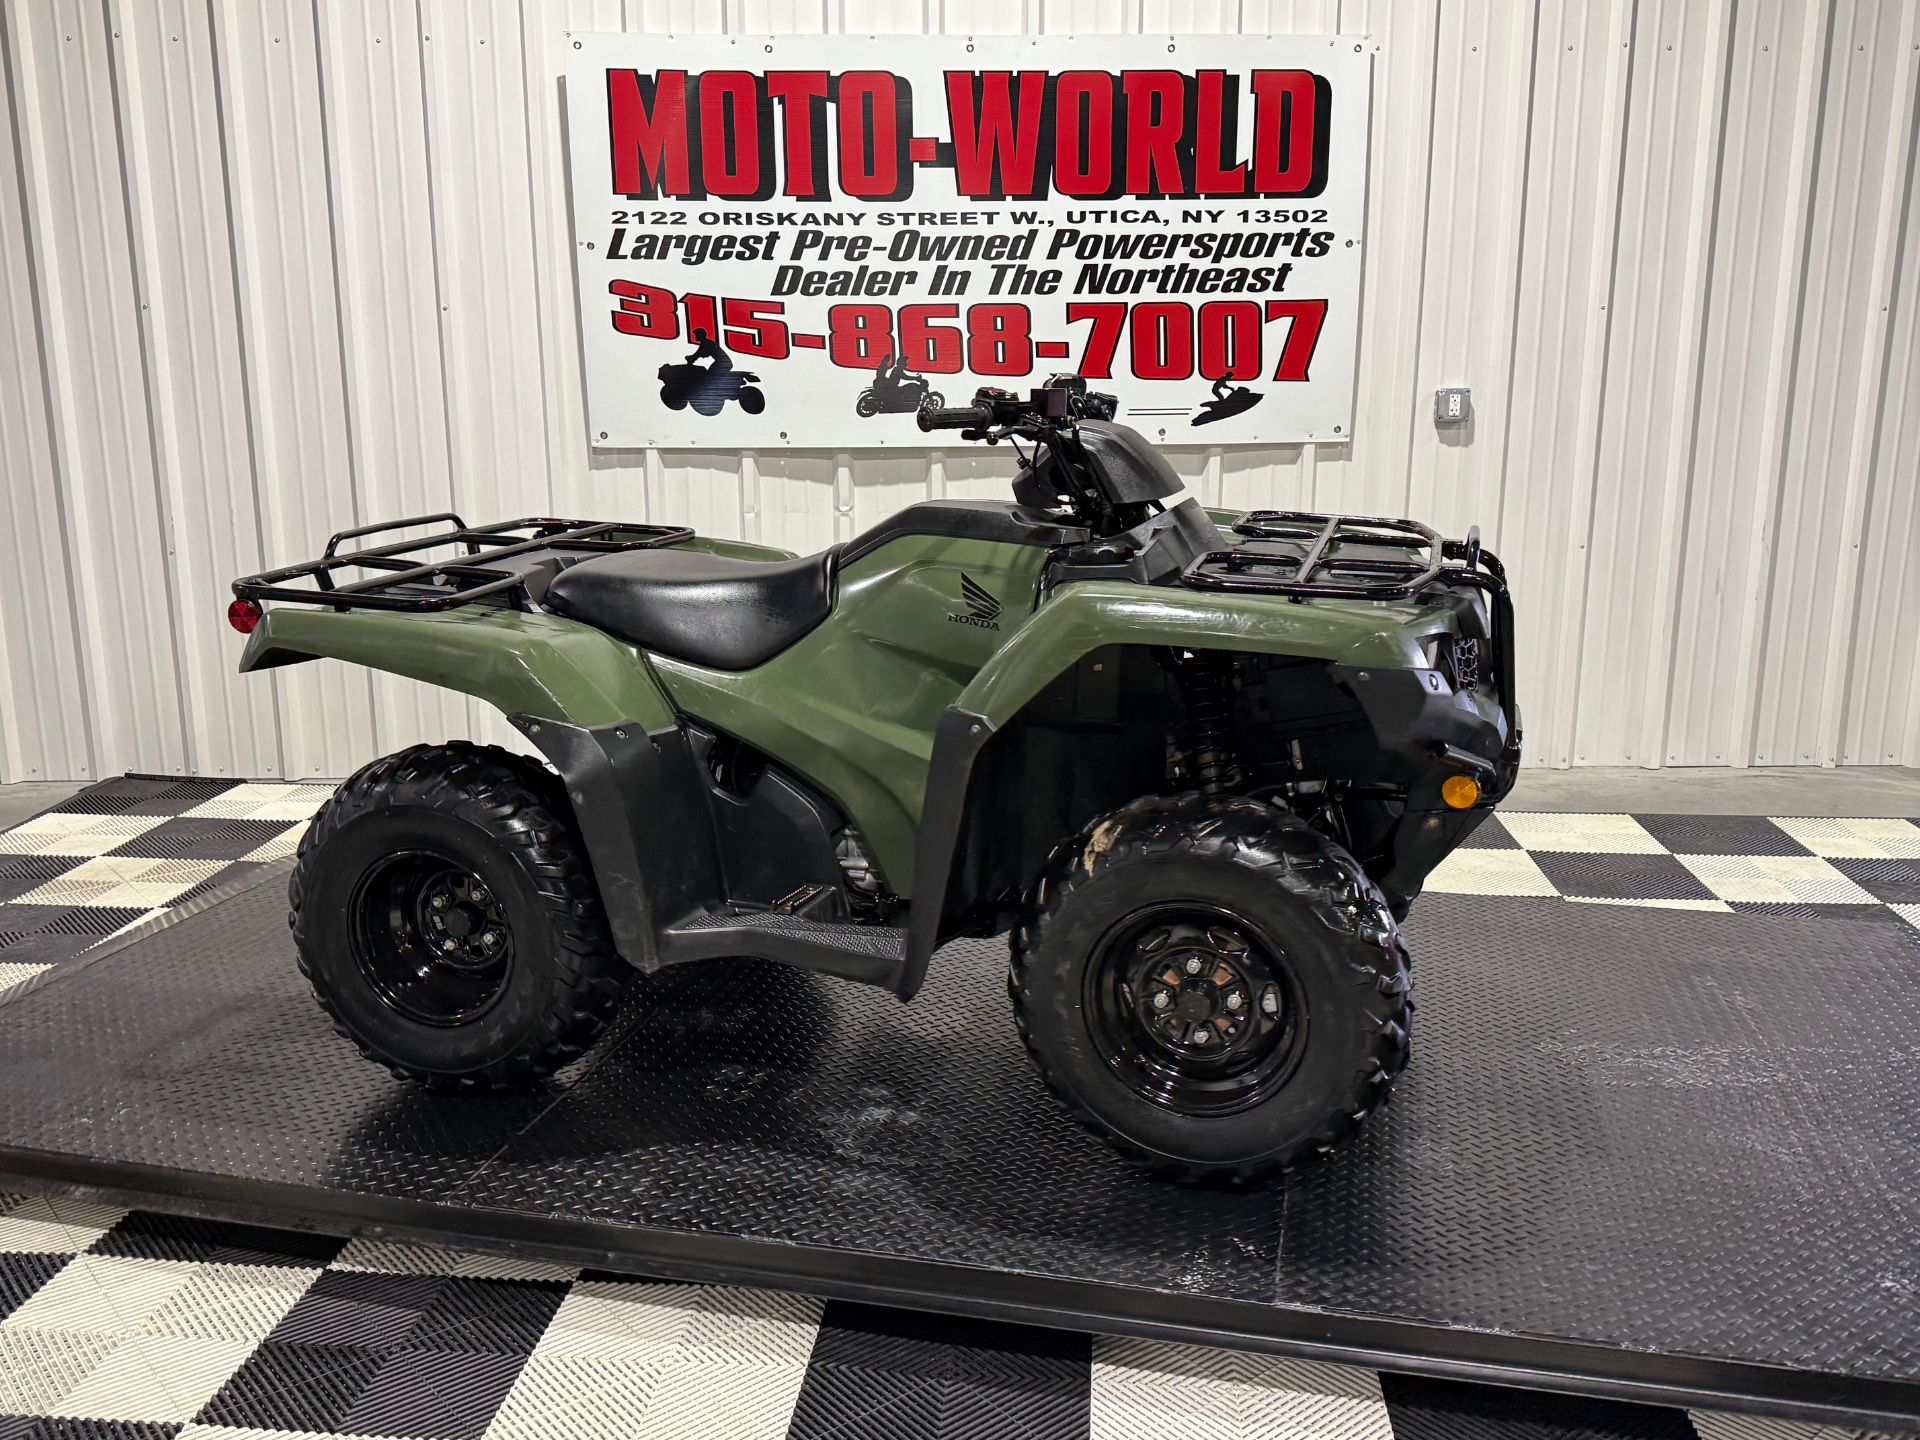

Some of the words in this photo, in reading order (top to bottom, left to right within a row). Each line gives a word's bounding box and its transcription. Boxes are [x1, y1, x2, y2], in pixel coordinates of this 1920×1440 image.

[606, 68, 1332, 201] MOTO-WORLD
[611, 211, 687, 225] 2122
[698, 212, 867, 226] ORISKANY
[876, 212, 1000, 226] STREET
[1010, 212, 1053, 227] W.,
[1067, 210, 1169, 225] UTICA,
[1182, 210, 1225, 224] NY
[1237, 209, 1328, 223] 13502
[606, 228, 780, 265] Largest
[789, 229, 1039, 262] Pre-Owned
[1046, 228, 1335, 263] Powersports
[770, 265, 918, 296] Dealer
[927, 265, 972, 296] In
[988, 264, 1063, 295] The
[1073, 262, 1292, 295] Northeast
[608, 279, 1329, 382] 315-868-7007
[948, 614, 1000, 630] HONDA
